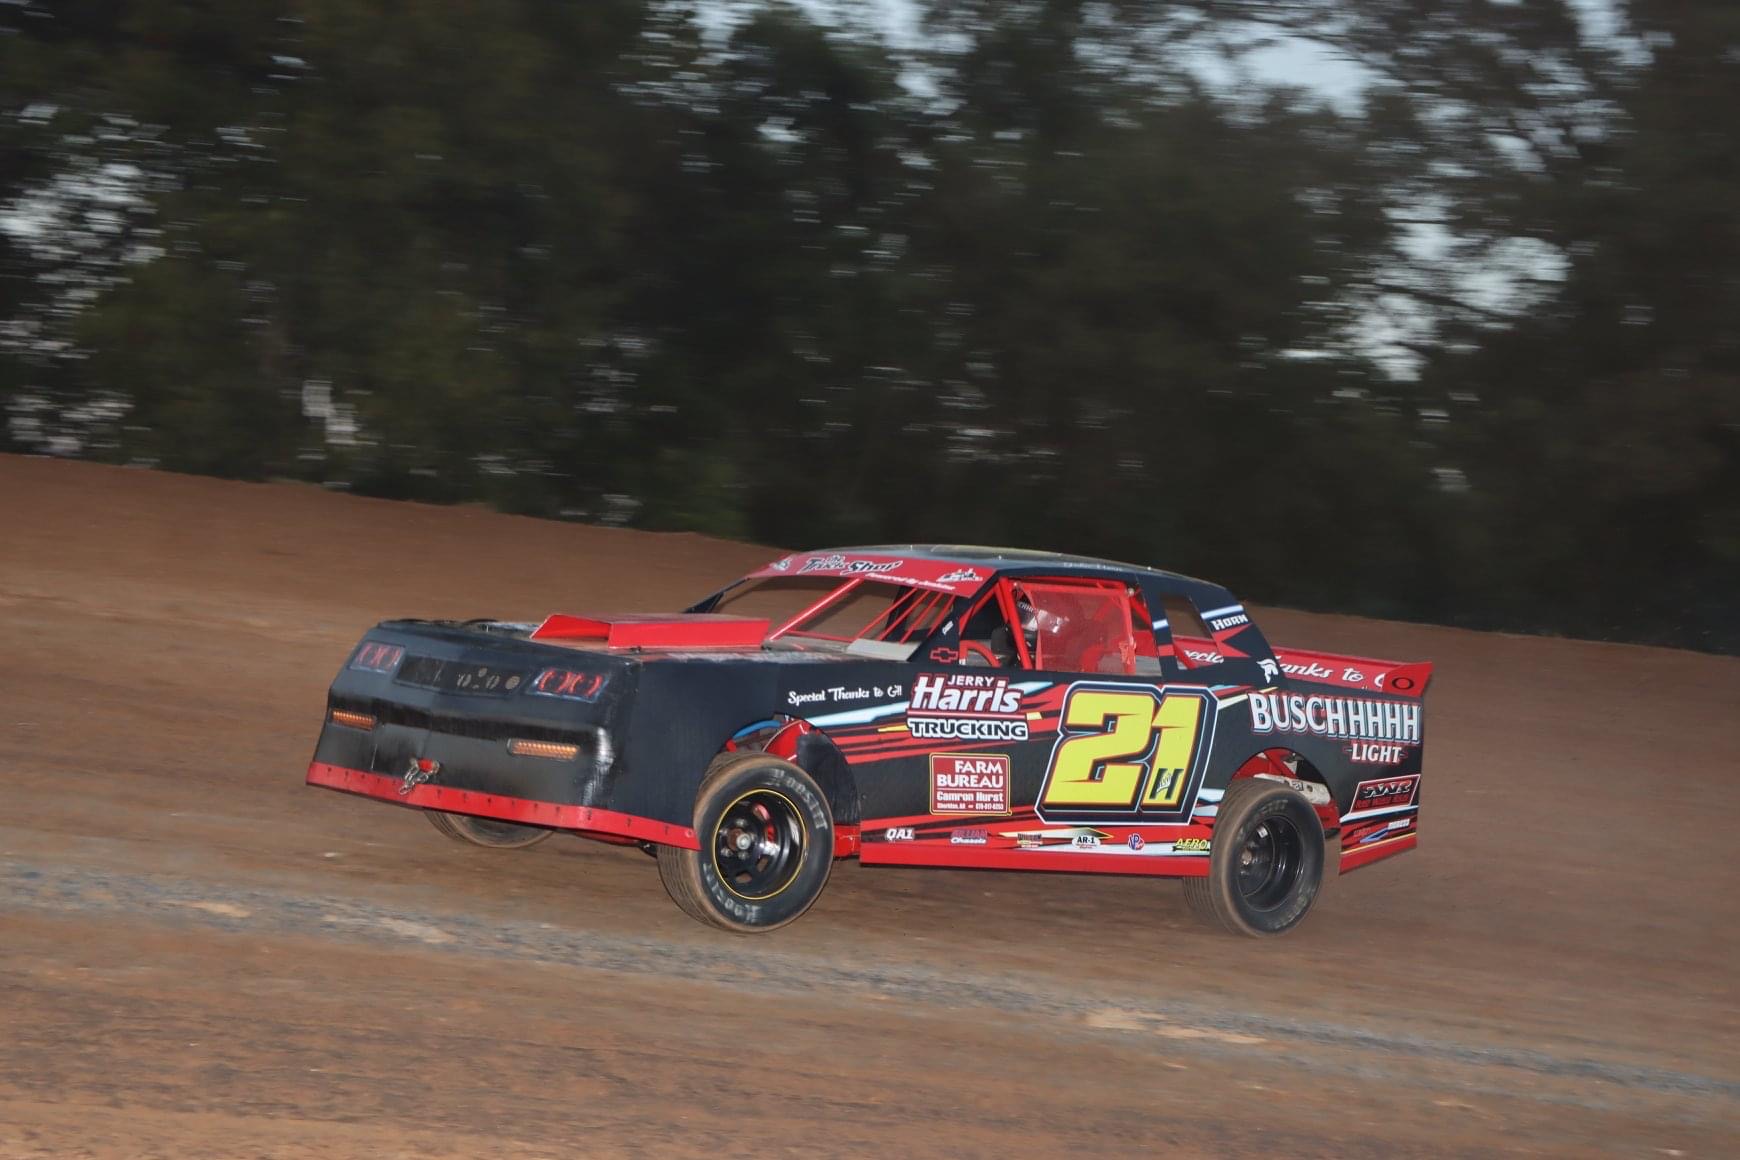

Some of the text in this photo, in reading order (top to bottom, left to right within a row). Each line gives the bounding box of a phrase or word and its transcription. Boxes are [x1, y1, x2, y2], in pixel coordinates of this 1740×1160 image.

[840, 560, 903, 575] Shop
[1277, 657, 1334, 678] anks
[1342, 667, 1364, 682] to
[948, 675, 995, 687] JERRY
[787, 690, 826, 706] Special
[828, 686, 870, 701] Thanks
[873, 687, 884, 698] to
[911, 675, 1022, 713] Harris
[1247, 692, 1421, 743] BUSCHHHHH
[907, 719, 1028, 740] TRUCKING
[1351, 743, 1402, 764] LIGHT
[954, 760, 1004, 774] FARM
[936, 773, 1004, 788] BUREAU
[976, 791, 1004, 803] Hurst
[886, 828, 914, 840] QA1
[1076, 835, 1096, 844] AR-1
[1174, 838, 1208, 850] AERO
